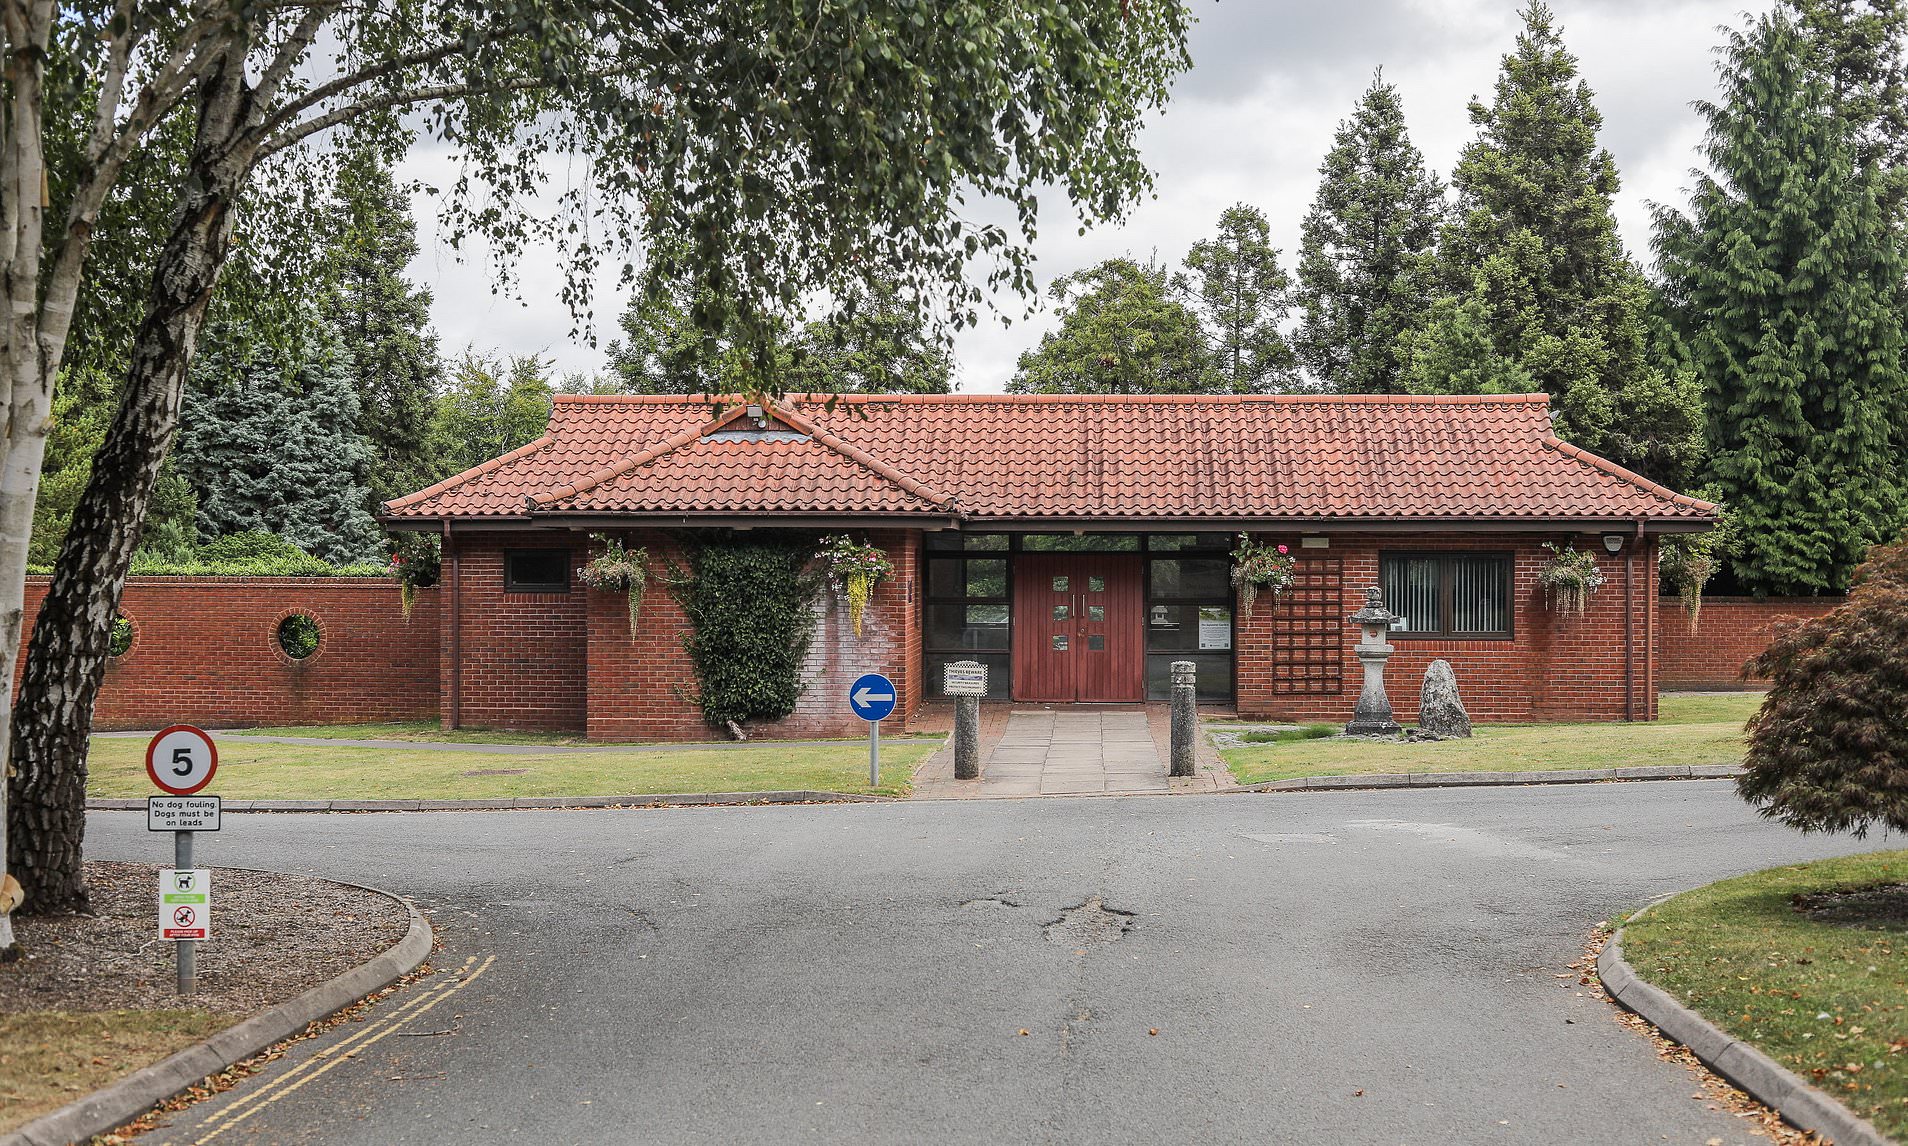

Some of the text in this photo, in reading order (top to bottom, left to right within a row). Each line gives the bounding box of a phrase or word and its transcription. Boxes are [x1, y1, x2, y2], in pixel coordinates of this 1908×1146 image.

[172, 748, 193, 777] 5
[167, 801, 183, 809] dog
[154, 810, 176, 818] Dogs
